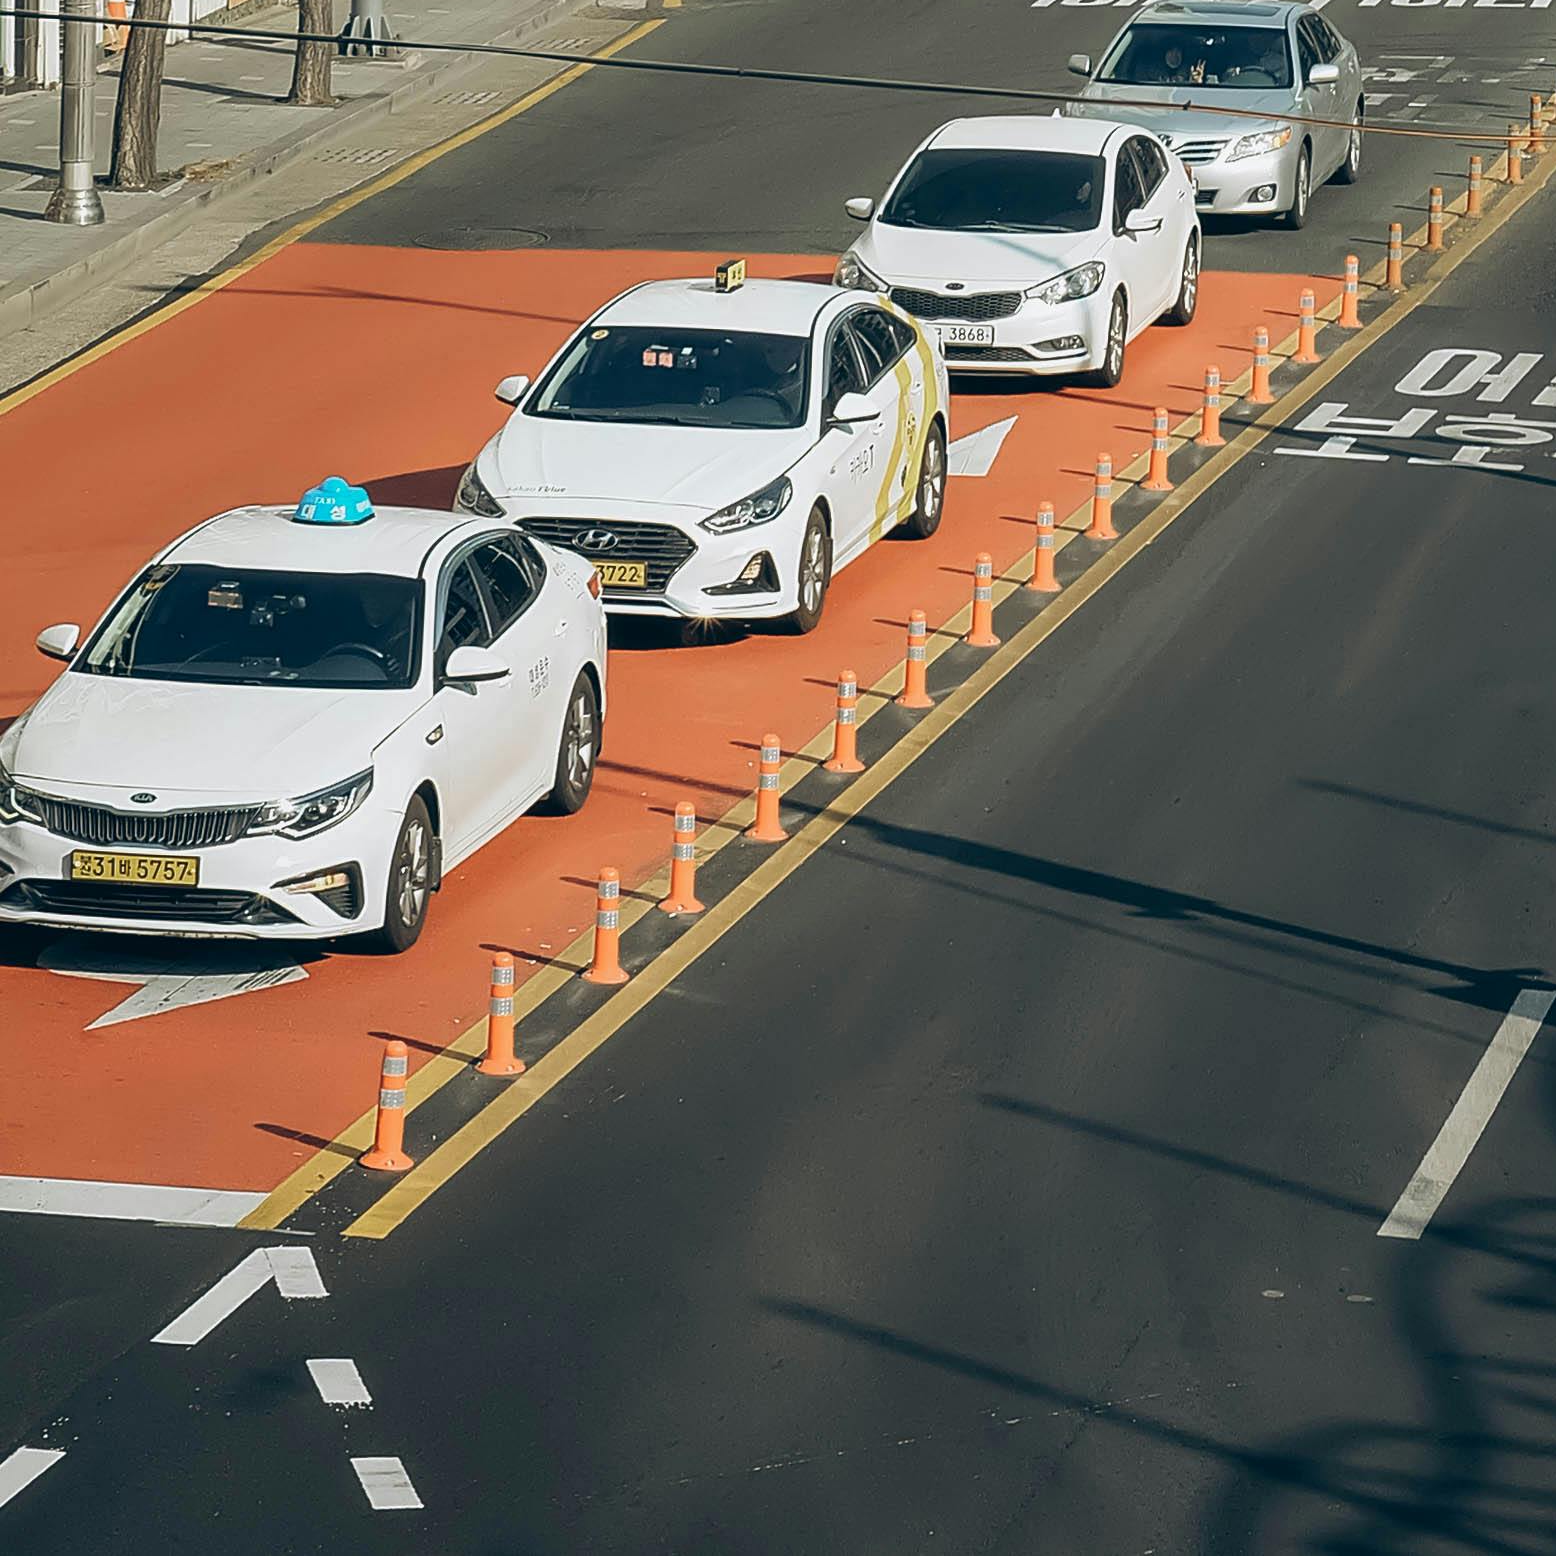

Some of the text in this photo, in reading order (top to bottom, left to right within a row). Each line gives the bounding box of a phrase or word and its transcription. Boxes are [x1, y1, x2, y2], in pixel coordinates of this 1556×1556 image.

[949, 327, 985, 341] 3868
[314, 496, 336, 504] TAXI
[137, 859, 189, 881] 5757
